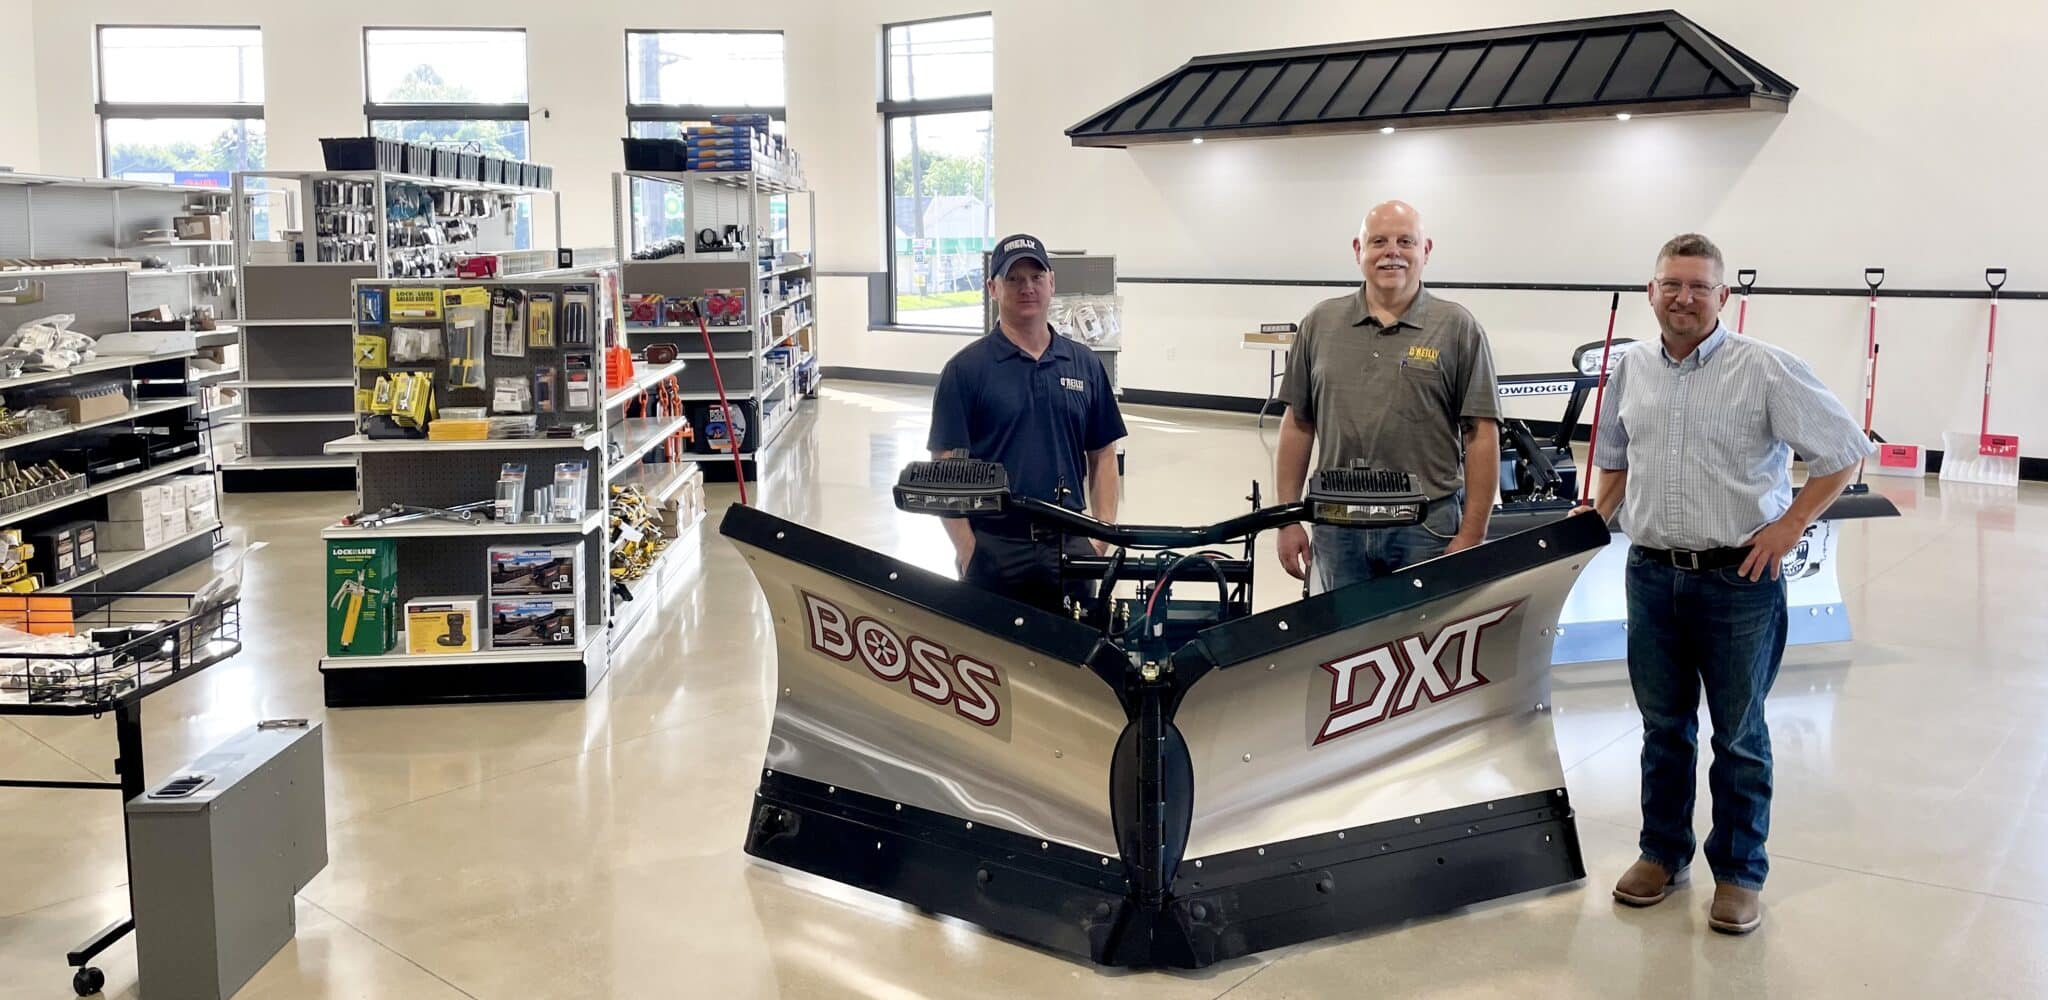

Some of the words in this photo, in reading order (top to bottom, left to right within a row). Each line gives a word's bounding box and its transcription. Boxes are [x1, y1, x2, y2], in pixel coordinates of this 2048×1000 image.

[1498, 384, 1569, 395] OWDOGG
[801, 589, 1001, 726] BOSS
[1312, 598, 1528, 746] DXT
